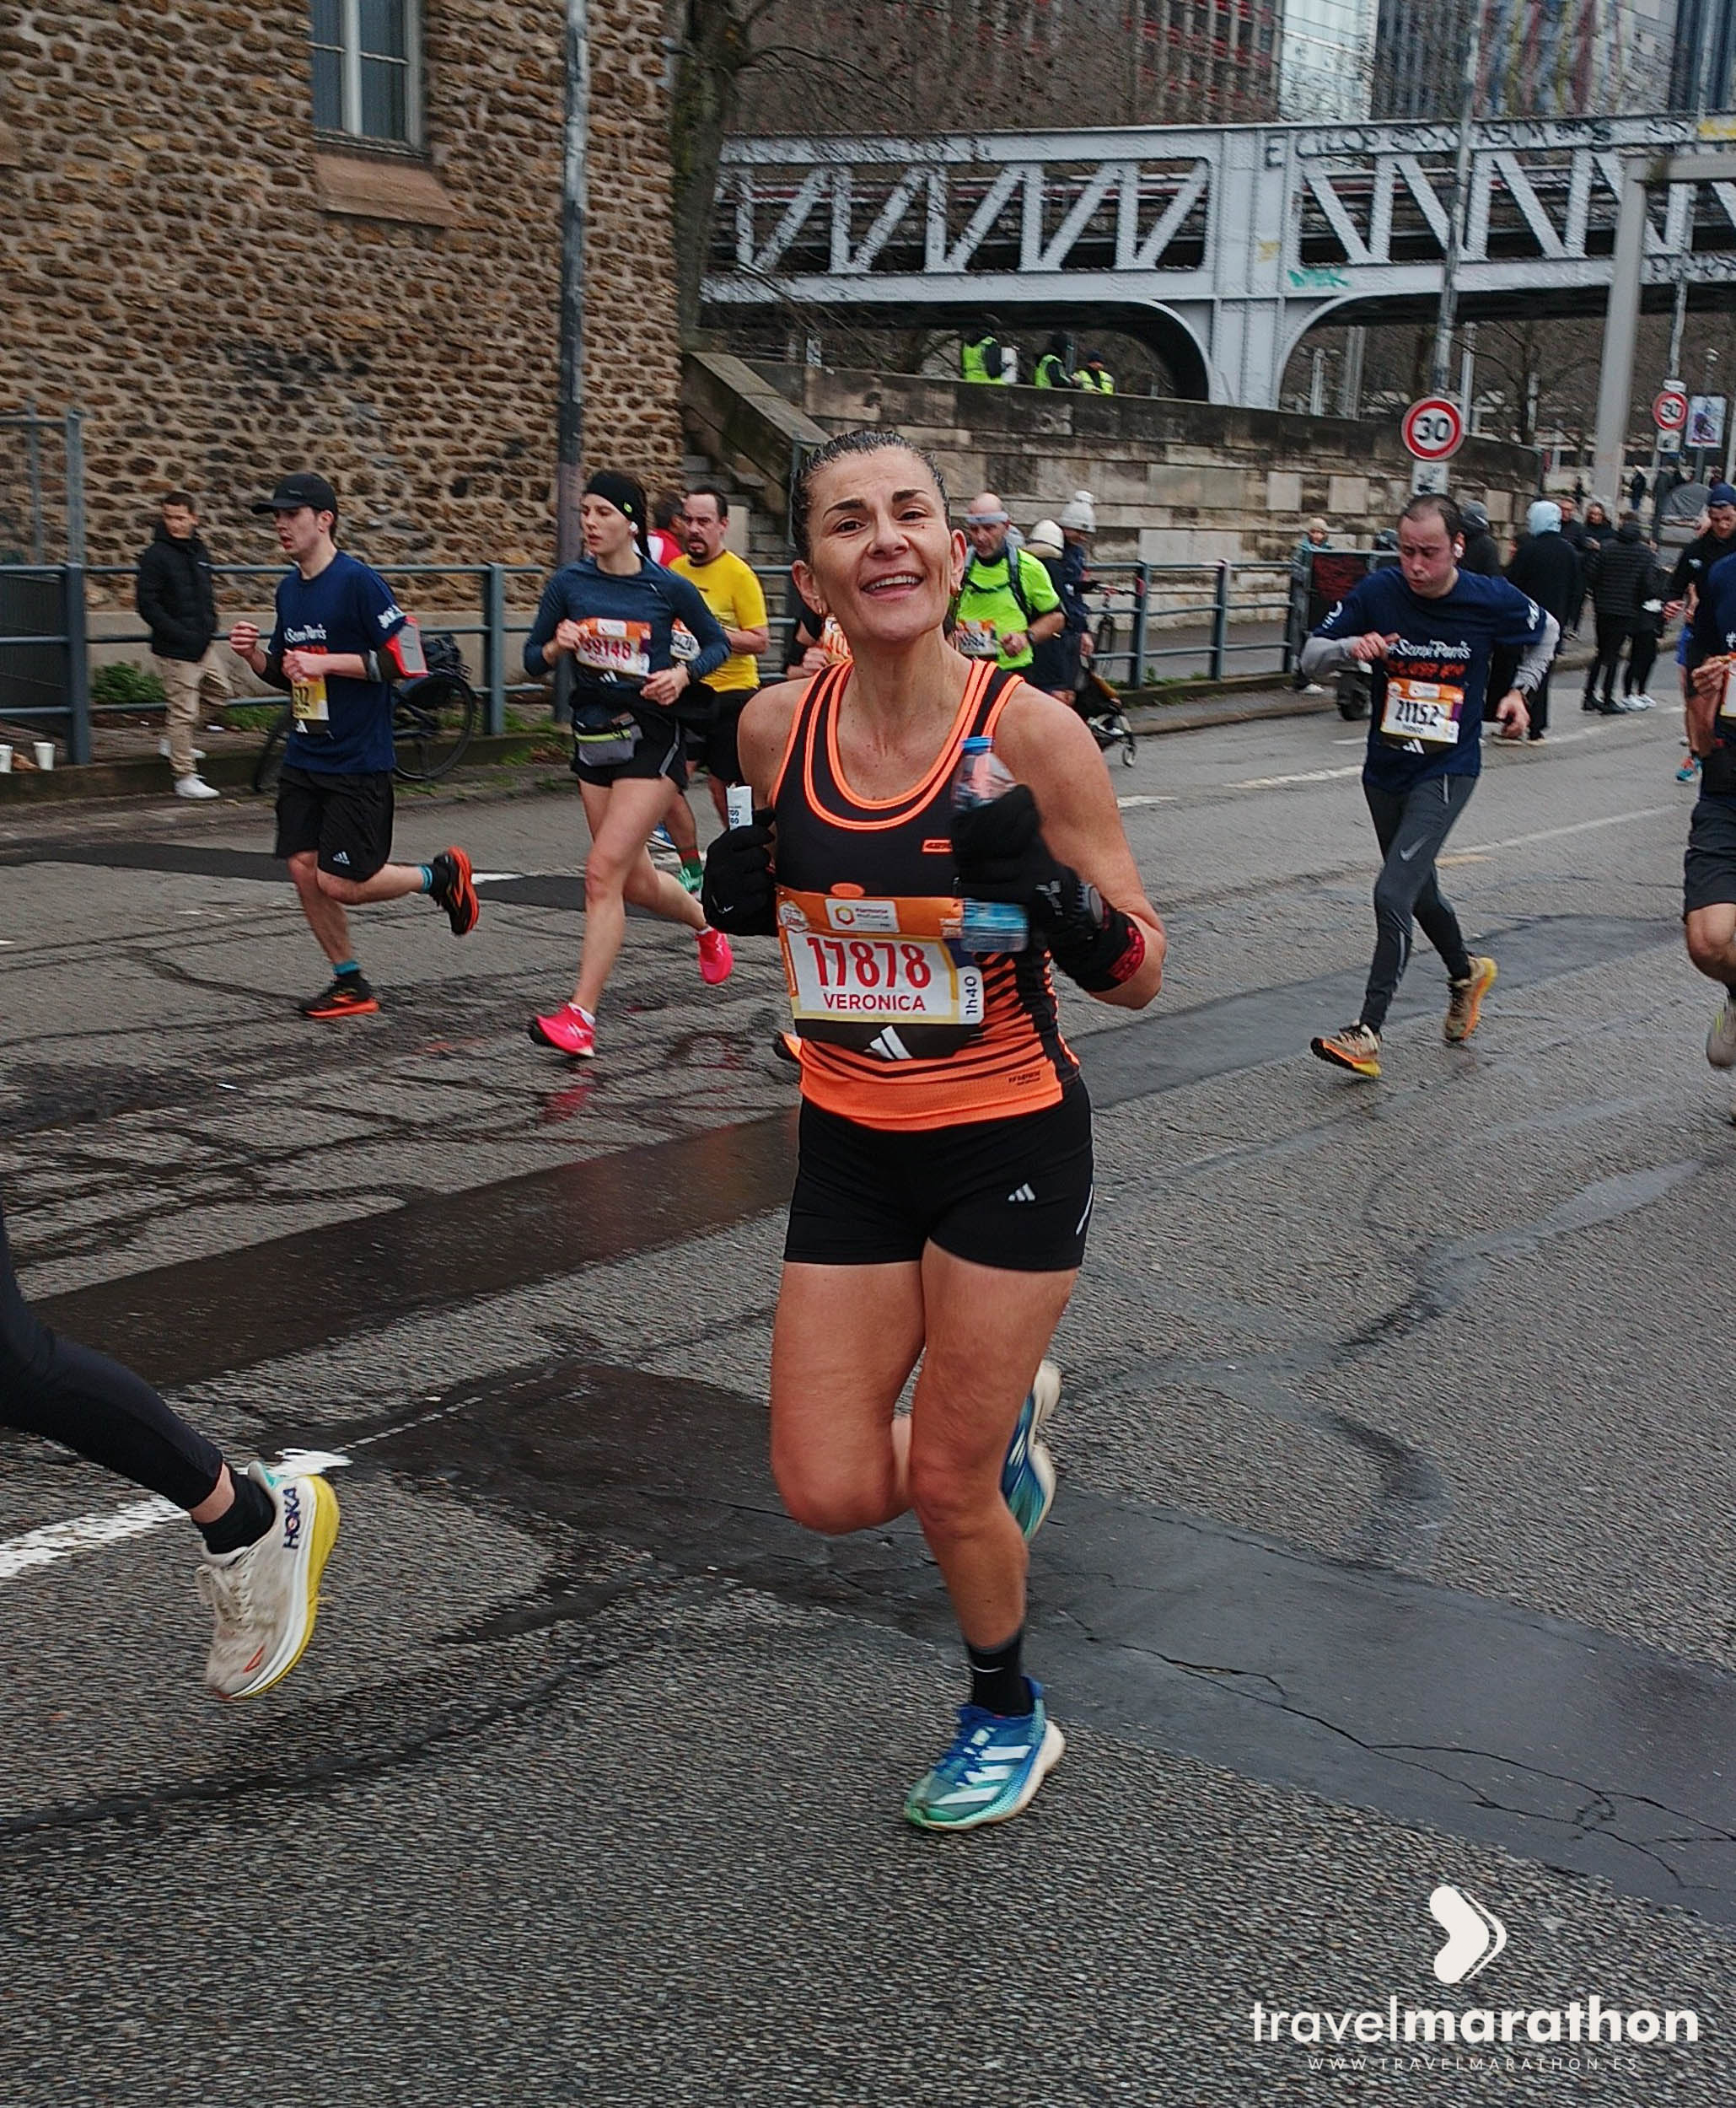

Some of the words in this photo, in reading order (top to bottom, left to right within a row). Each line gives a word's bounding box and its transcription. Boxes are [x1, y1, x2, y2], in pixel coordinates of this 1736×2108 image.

[1415, 417, 1449, 442] 30
[1395, 700, 1438, 727] 21152
[807, 937, 931, 988] 17878
[823, 993, 926, 1011] VERONICA
[965, 976, 978, 1014] 1h40
[282, 1487, 300, 1549] HOKA
